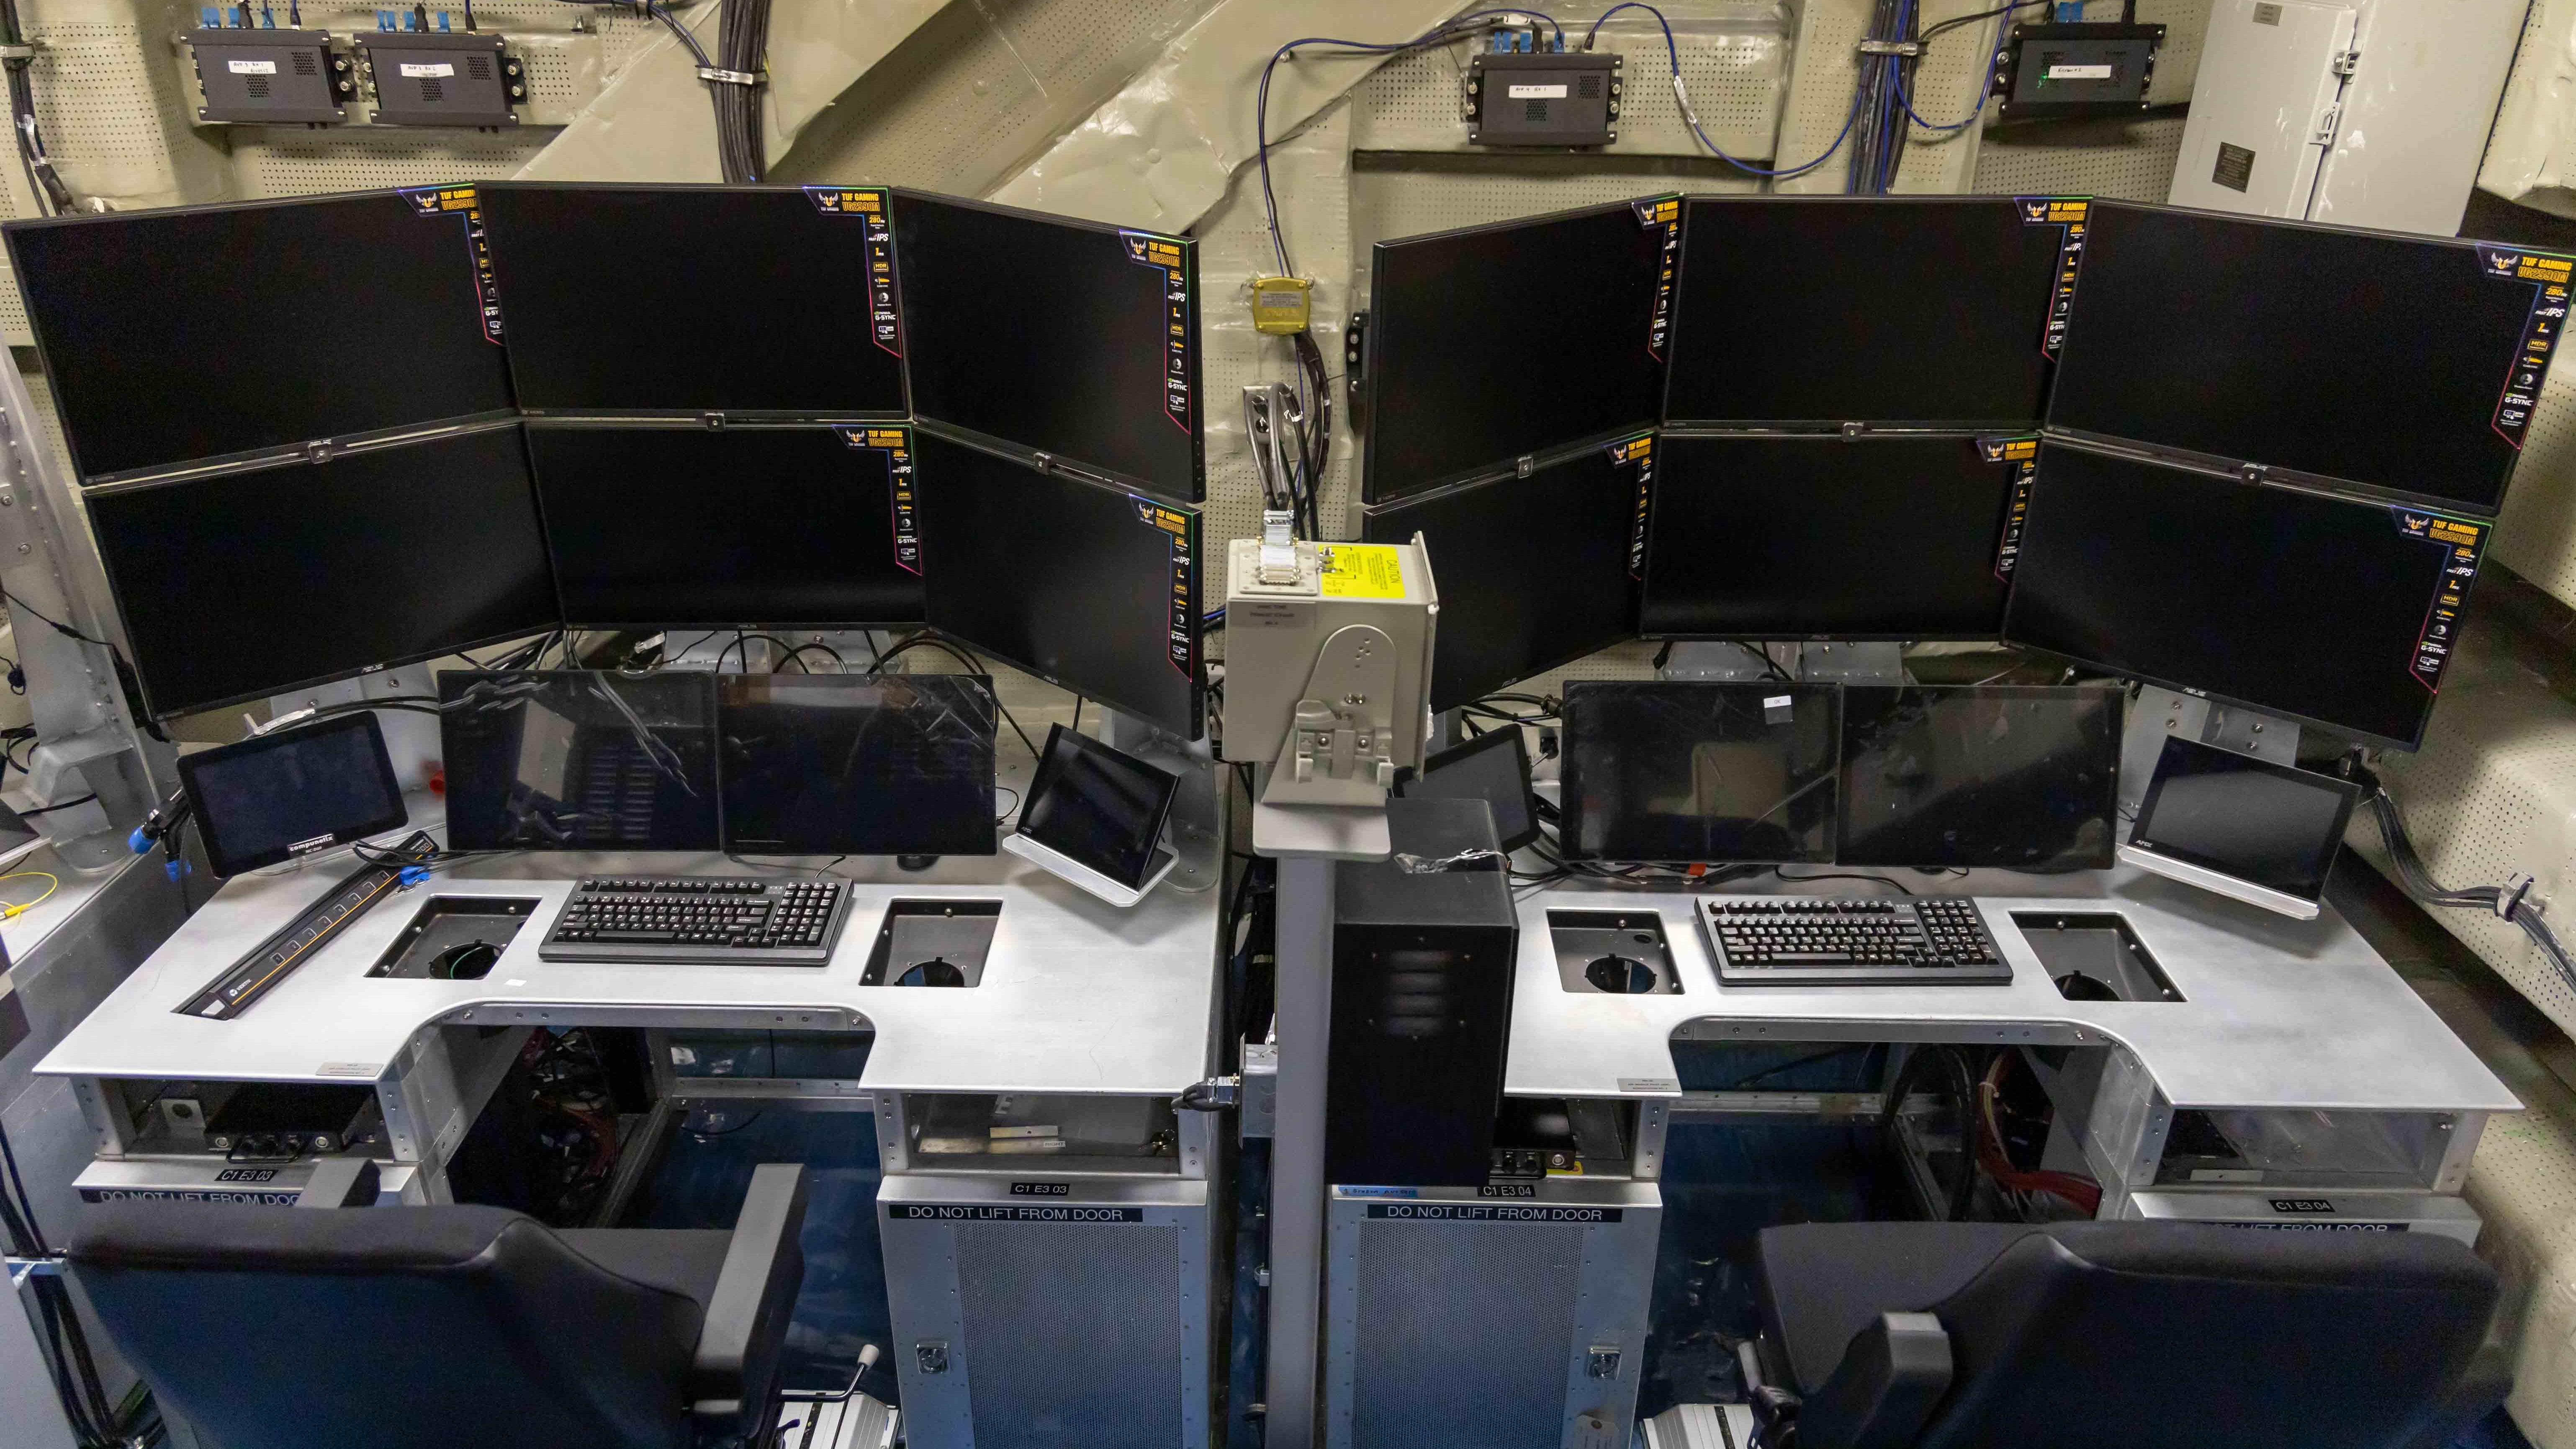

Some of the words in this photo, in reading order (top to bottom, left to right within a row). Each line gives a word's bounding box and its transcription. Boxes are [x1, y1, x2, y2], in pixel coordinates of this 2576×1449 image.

[440, 192, 452, 200] TUF
[453, 189, 476, 199] GAMIN
[1149, 242, 1158, 251] TUF
[1159, 244, 1179, 255] GAMING
[2522, 257, 2537, 265] TUF
[2538, 259, 2572, 271] GAMING
[1175, 292, 1185, 302] IPS
[2546, 308, 2565, 317] IPS
[2505, 397, 2533, 406] G-SYNC
[1156, 508, 1165, 518] TUF
[1166, 511, 1185, 524] GAMING
[2433, 520, 2447, 529] TUF
[2448, 523, 2478, 535] GAMING
[1179, 556, 1190, 566] IPS
[1387, 560, 1400, 584] CAUTION
[2457, 567, 2473, 577] IPS
[1171, 634, 1190, 643] G-SYNC
[2421, 646, 2448, 654] G-SYNC
[289, 836, 333, 851] compunetix
[222, 1170, 239, 1180] C1
[239, 1171, 256, 1180] E3
[256, 1171, 273, 1180] 03
[1483, 1186, 1497, 1195] C1
[1501, 1186, 1515, 1195] E3
[1518, 1186, 1531, 1196] 04
[100, 1191, 125, 1202] DO
[131, 1192, 165, 1201] NOT
[211, 1193, 260, 1204] FROM
[909, 1207, 934, 1218] DO
[939, 1207, 974, 1218] NOT
[980, 1207, 1013, 1218] LIFT
[1019, 1208, 1067, 1219] FROM
[1074, 1209, 1123, 1220] DOOR
[1388, 1206, 1411, 1217] DO
[1418, 1207, 1452, 1217] NOT
[1458, 1207, 1492, 1218] LIFT
[1499, 1208, 1547, 1219] FROM
[1553, 1210, 1602, 1220] DOOR
